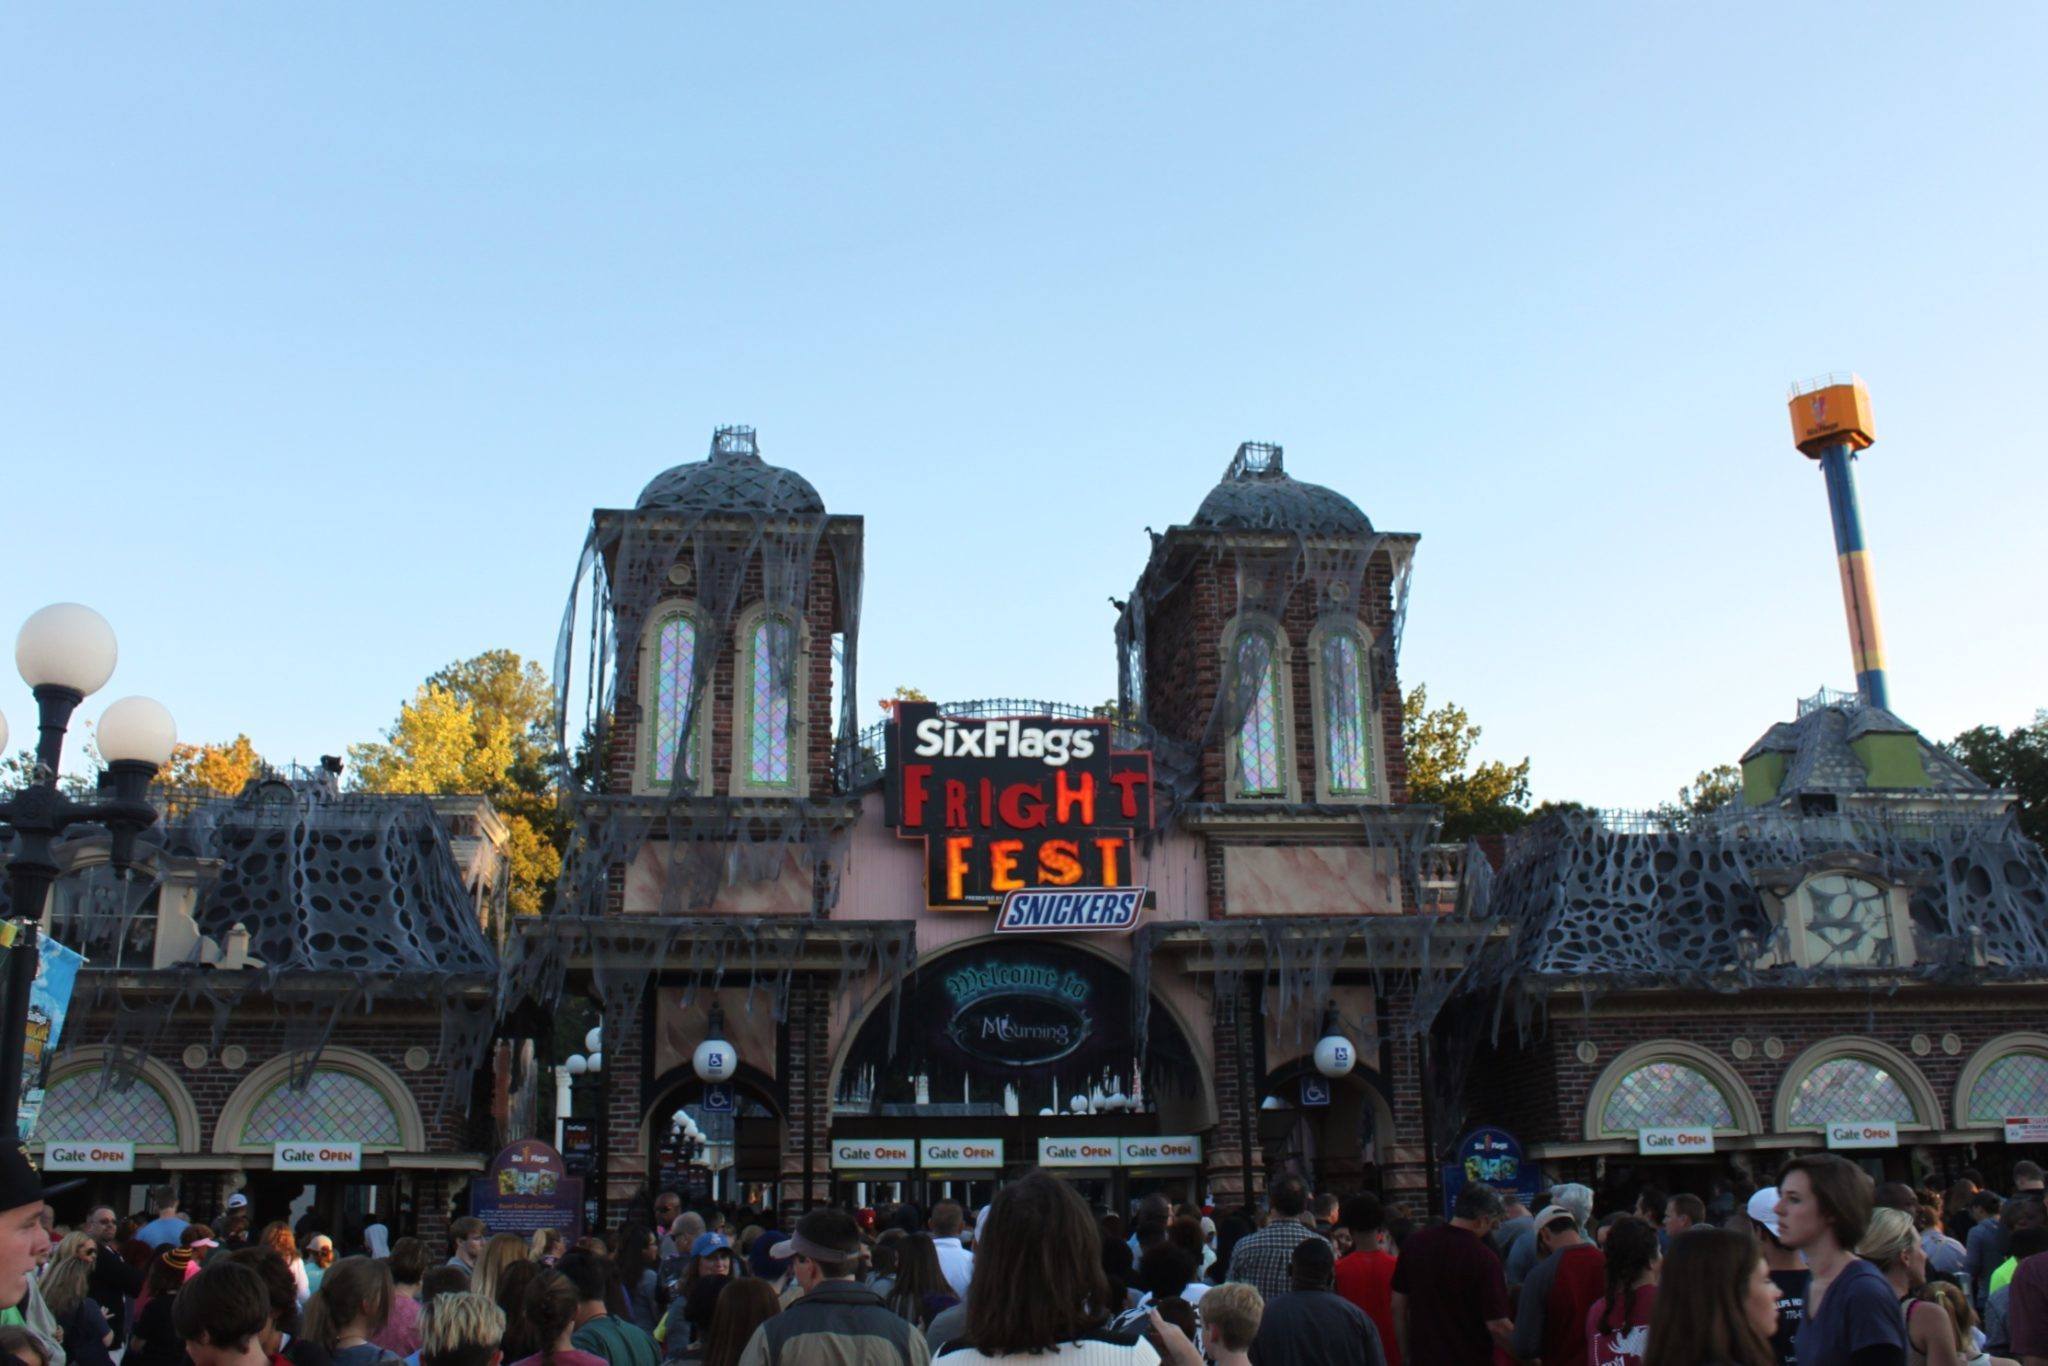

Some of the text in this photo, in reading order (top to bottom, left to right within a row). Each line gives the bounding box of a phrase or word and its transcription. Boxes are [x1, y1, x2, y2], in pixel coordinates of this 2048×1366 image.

[915, 718, 1095, 766] SixFlags
[904, 764, 1147, 829] FRIGHT
[946, 836, 1124, 900] FEST
[1008, 892, 1134, 926] SNICKERS
[948, 963, 1087, 999] Welcome to
[981, 1014, 1069, 1045] Mourning
[1646, 1134, 1706, 1147] Gate OPEN
[1833, 1128, 1859, 1141] Gate
[53, 1148, 86, 1161] Gate
[90, 1148, 124, 1161] OPEN
[282, 1148, 352, 1161] Gate OPEN
[839, 1147, 906, 1160] Gate OPEN
[928, 1146, 994, 1159] Gate OPEN
[1046, 1145, 1111, 1158] Gate OPEN
[1127, 1144, 1191, 1157] Gate OPEN
